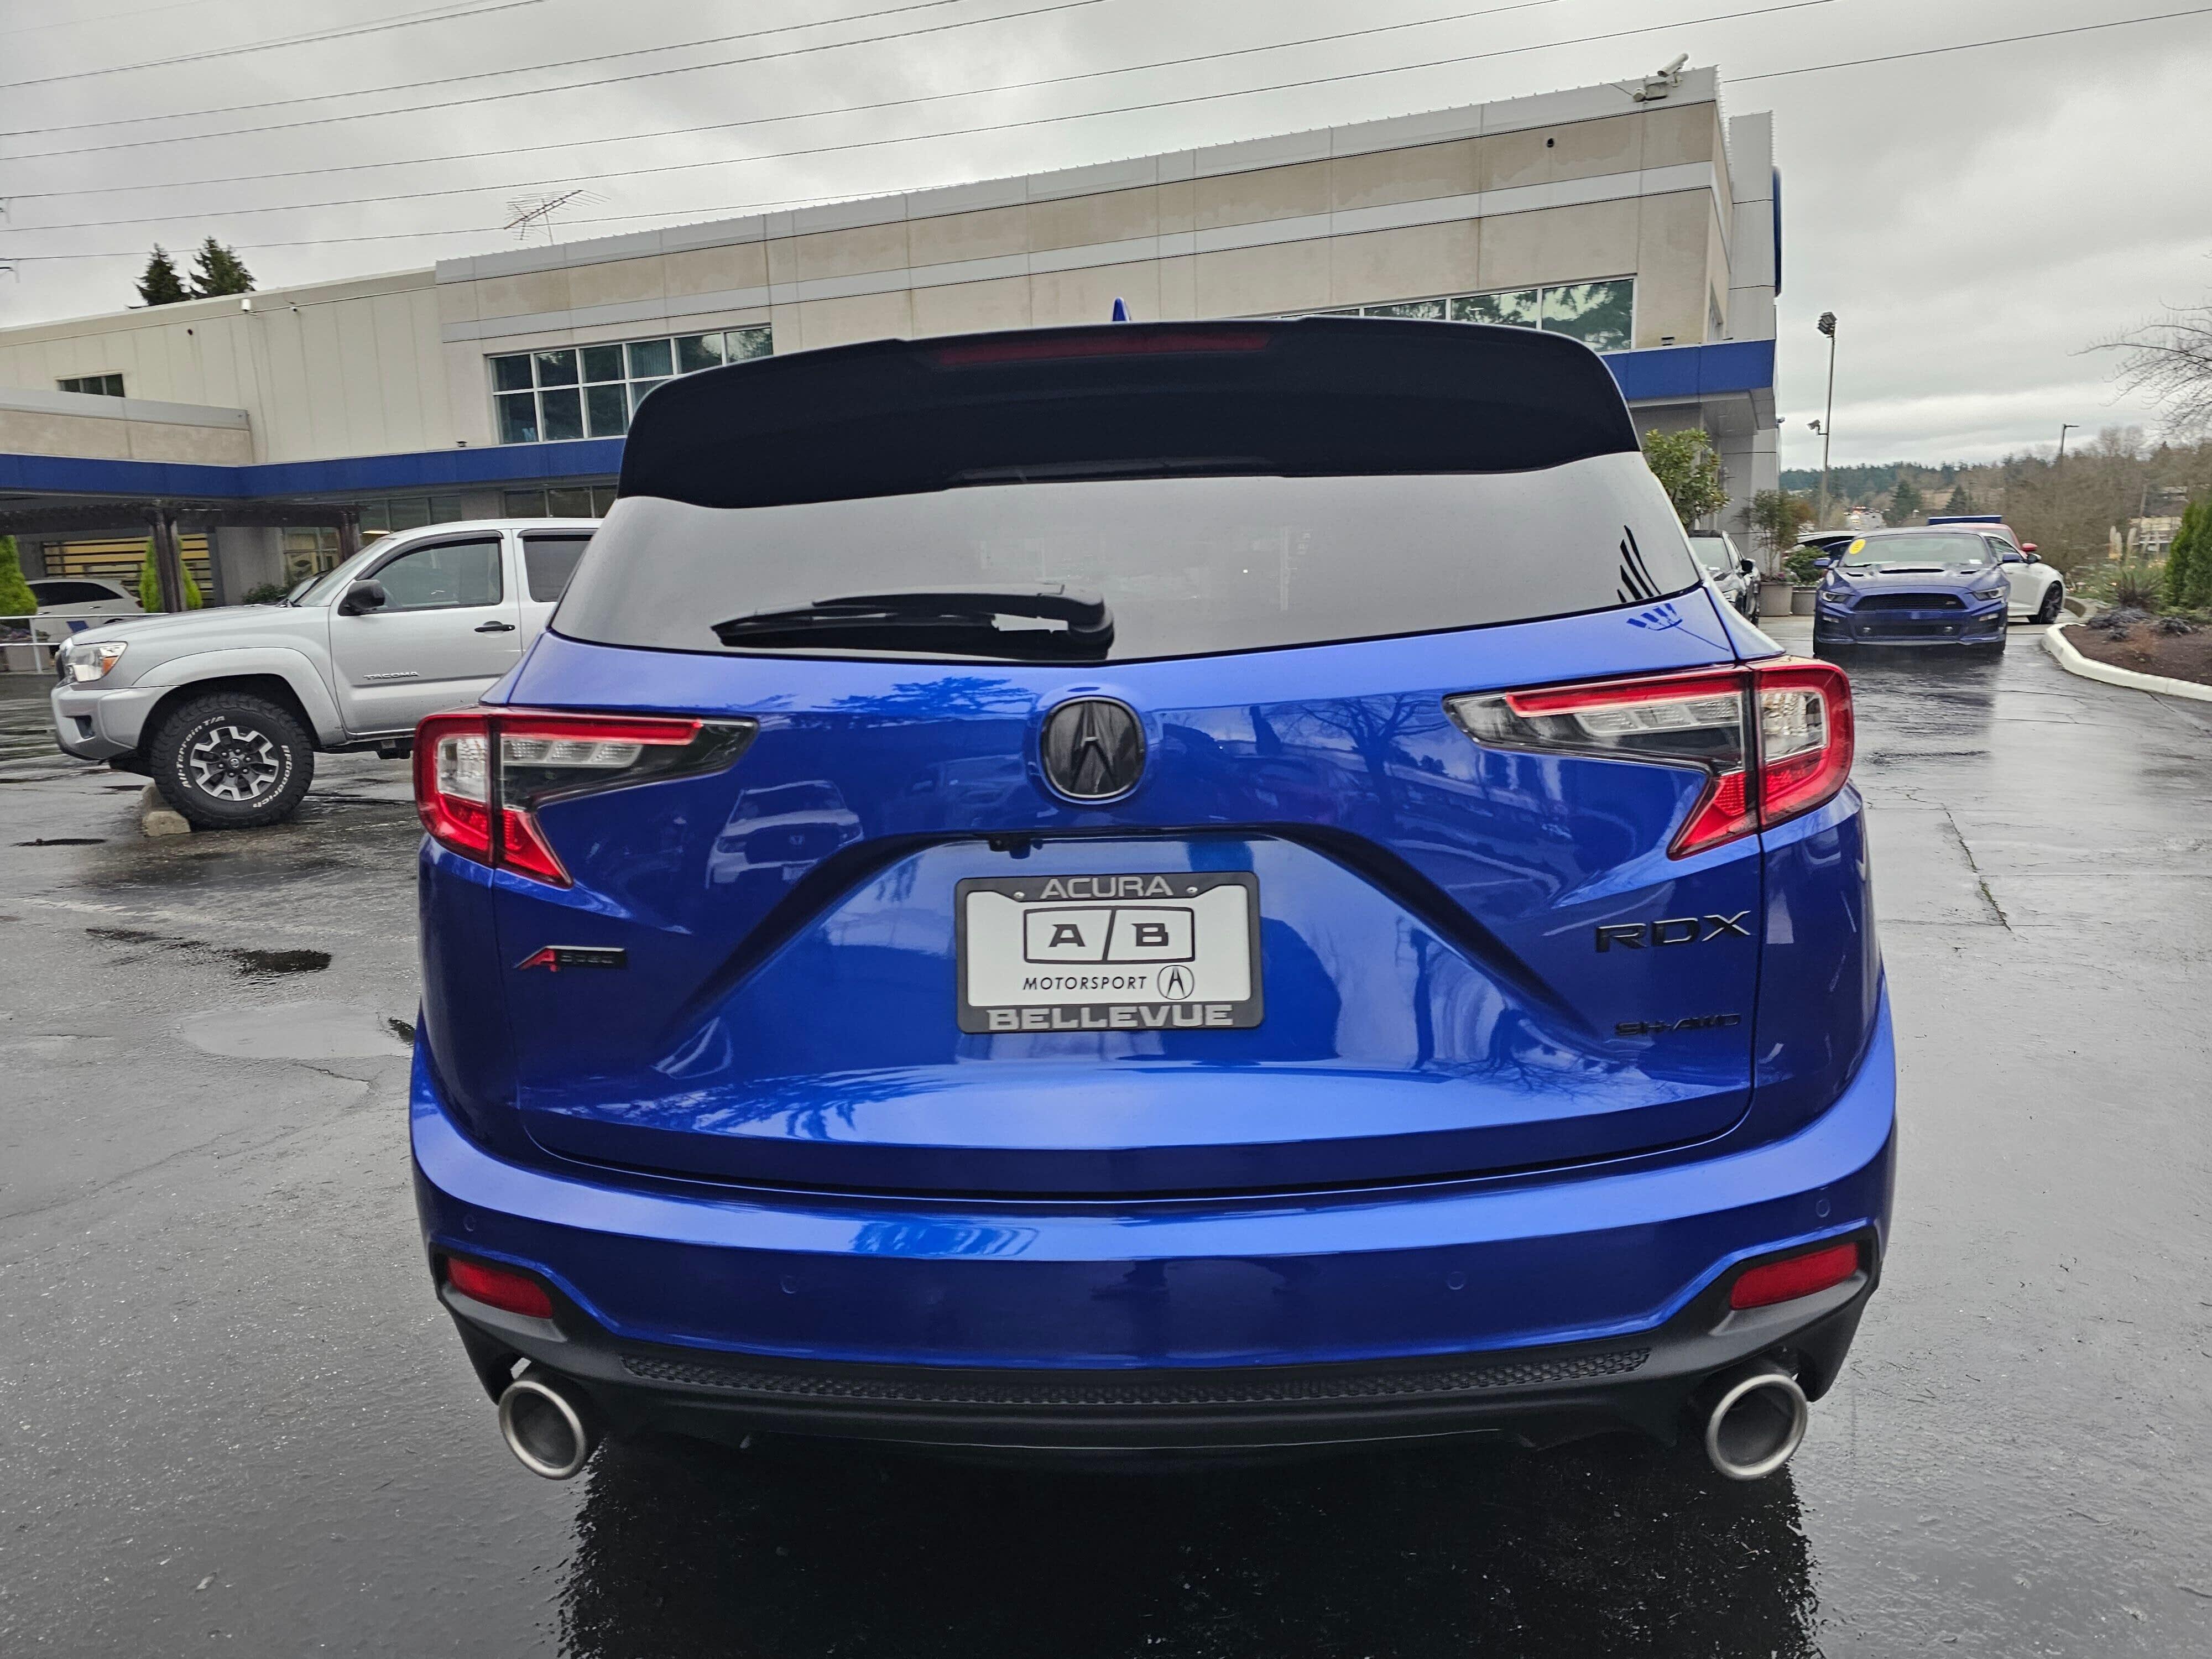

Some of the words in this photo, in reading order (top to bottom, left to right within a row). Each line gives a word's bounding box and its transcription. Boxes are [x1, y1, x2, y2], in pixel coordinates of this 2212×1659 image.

[363, 671, 420, 680] TACOMA
[202, 716, 225, 726] T/A
[253, 745, 293, 808] BFGoodrich
[1040, 876, 1173, 899] ACURA
[1048, 924, 1086, 947] A
[1131, 922, 1169, 947] B
[1595, 910, 1752, 953] RDX
[1022, 976, 1147, 990] MOTORSPORT
[986, 1004, 1235, 1031] BELLEVUE
